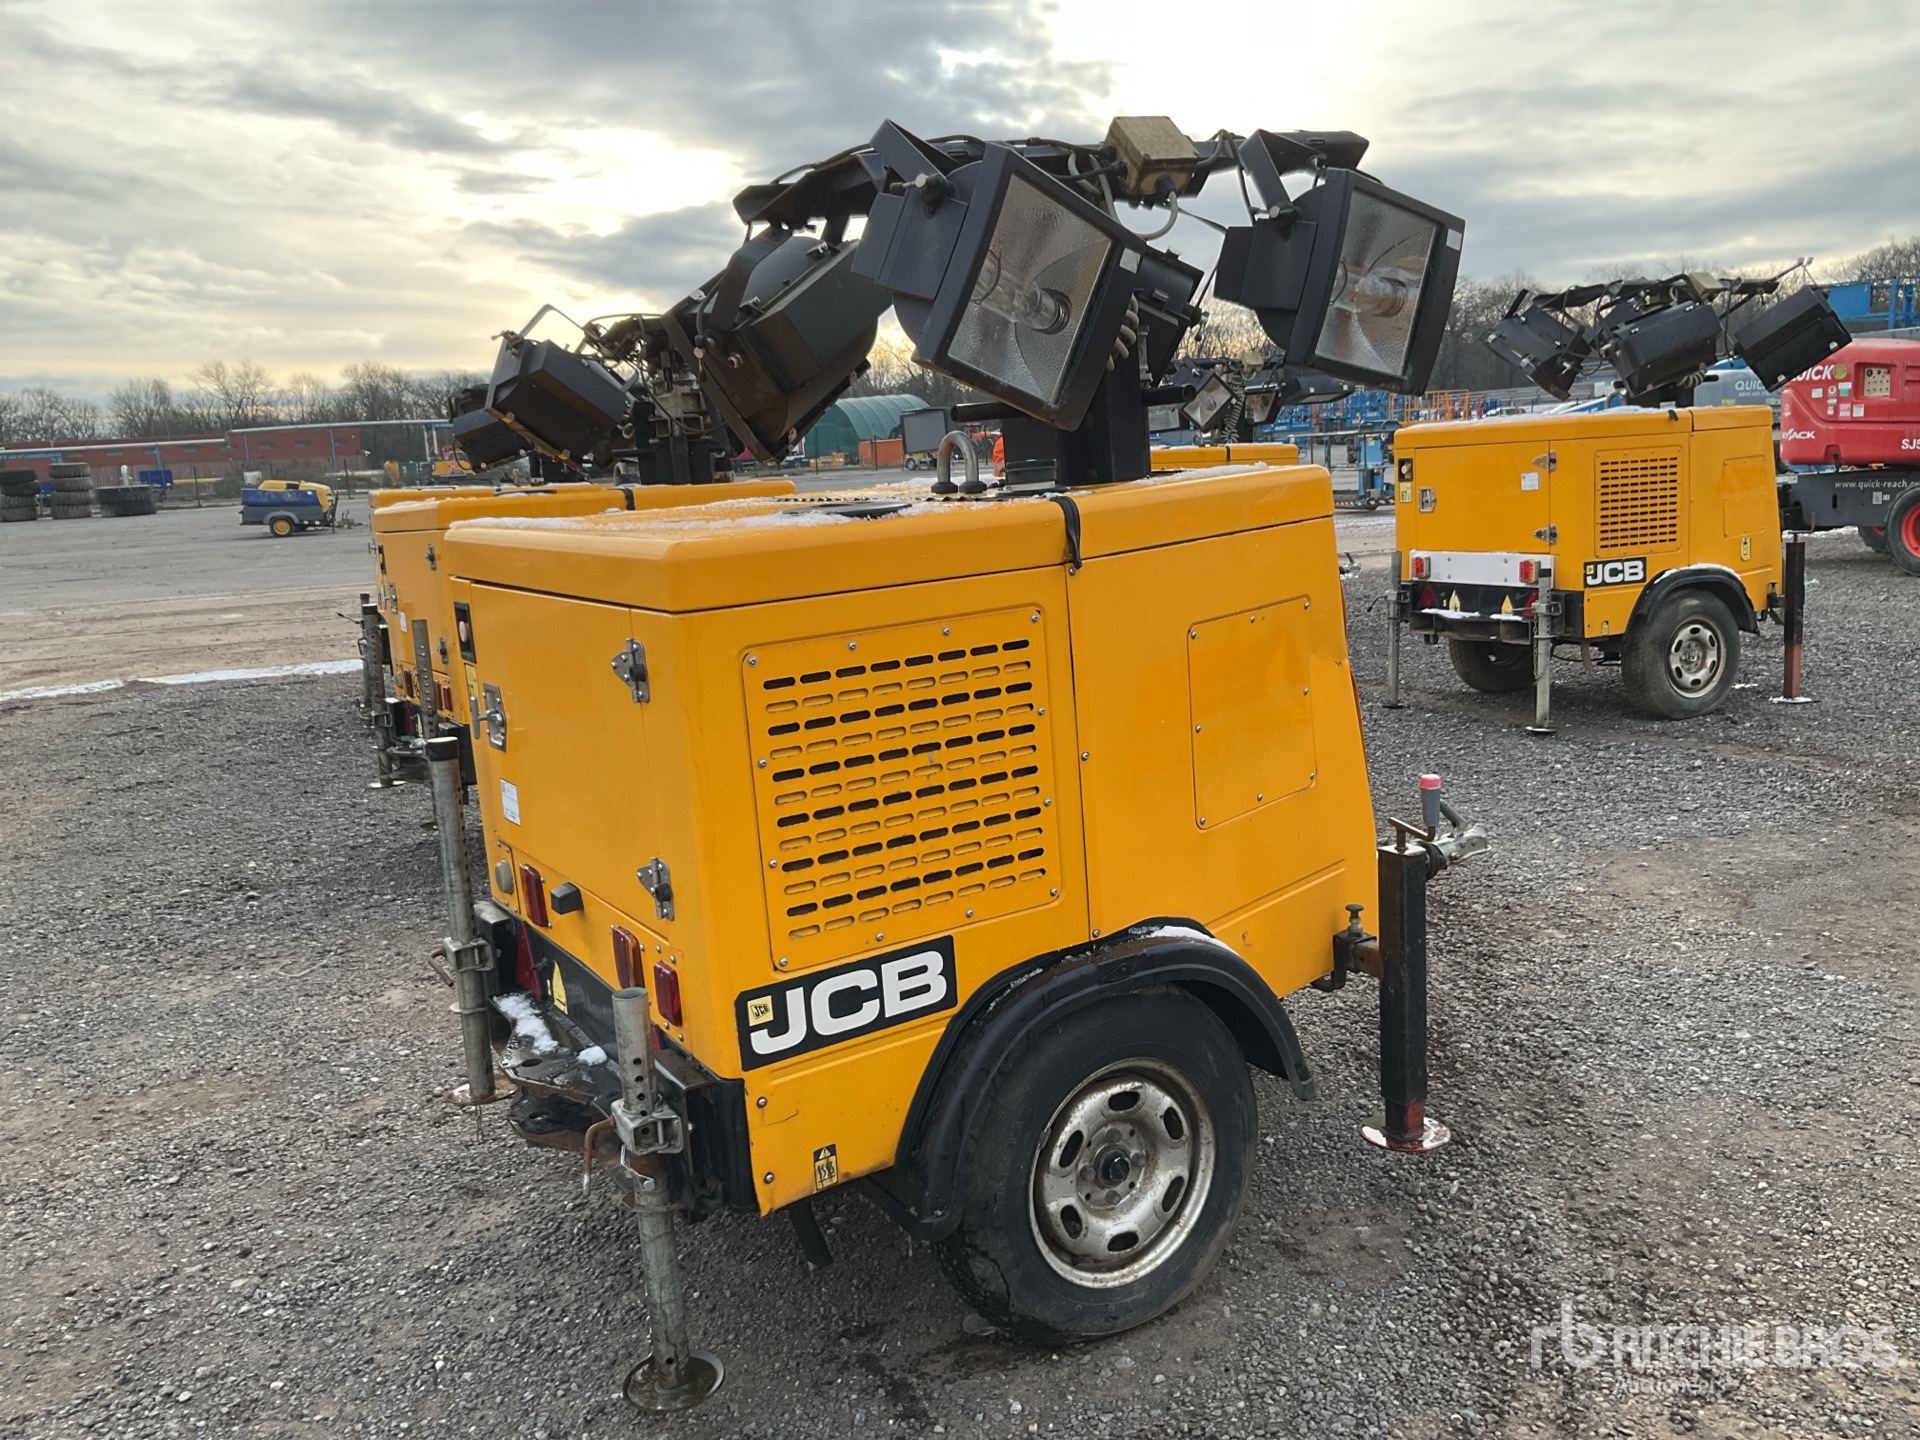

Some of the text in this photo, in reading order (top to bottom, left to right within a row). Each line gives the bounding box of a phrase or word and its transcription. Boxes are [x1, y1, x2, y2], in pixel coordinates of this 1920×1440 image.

[1792, 364, 1835, 381] UICK
[1735, 380, 1764, 391] QUIC
[1586, 560, 1644, 586] JCB
[749, 950, 948, 1055] JCB
[754, 1004, 770, 1018] JCB
